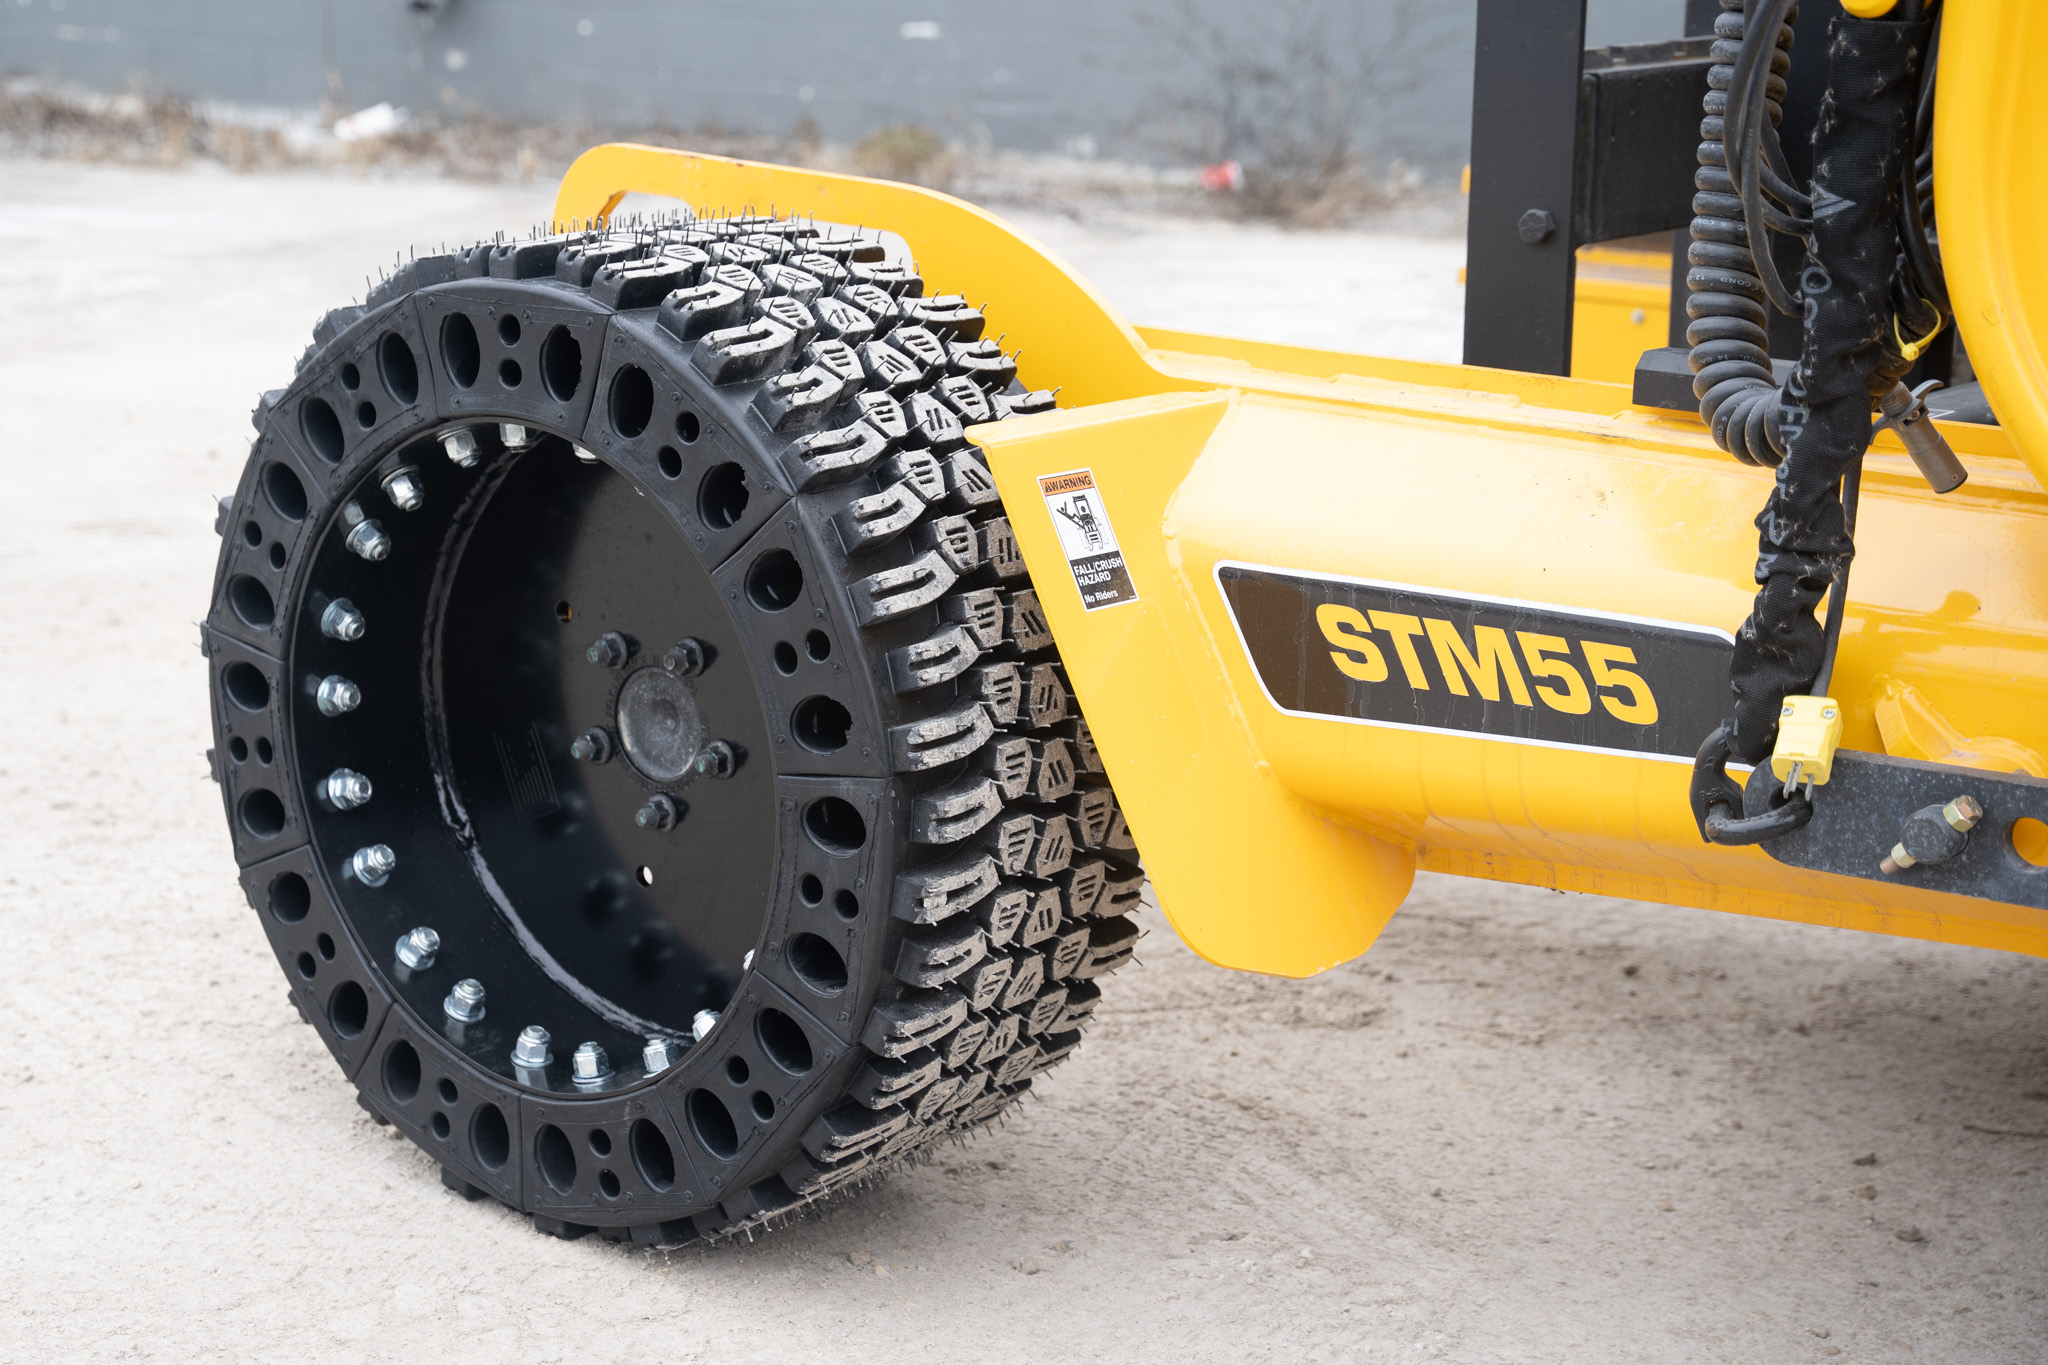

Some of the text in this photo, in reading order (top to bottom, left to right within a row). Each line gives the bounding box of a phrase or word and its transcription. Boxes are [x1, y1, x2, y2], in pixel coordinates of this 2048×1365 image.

[1050, 475, 1092, 492] WARNING
[1073, 556, 1123, 576] FALL/CRUSH
[1077, 571, 1111, 587] HAZARD
[1084, 594, 1095, 604] No
[1095, 589, 1119, 602] Riders
[1315, 603, 1659, 725] STM55
